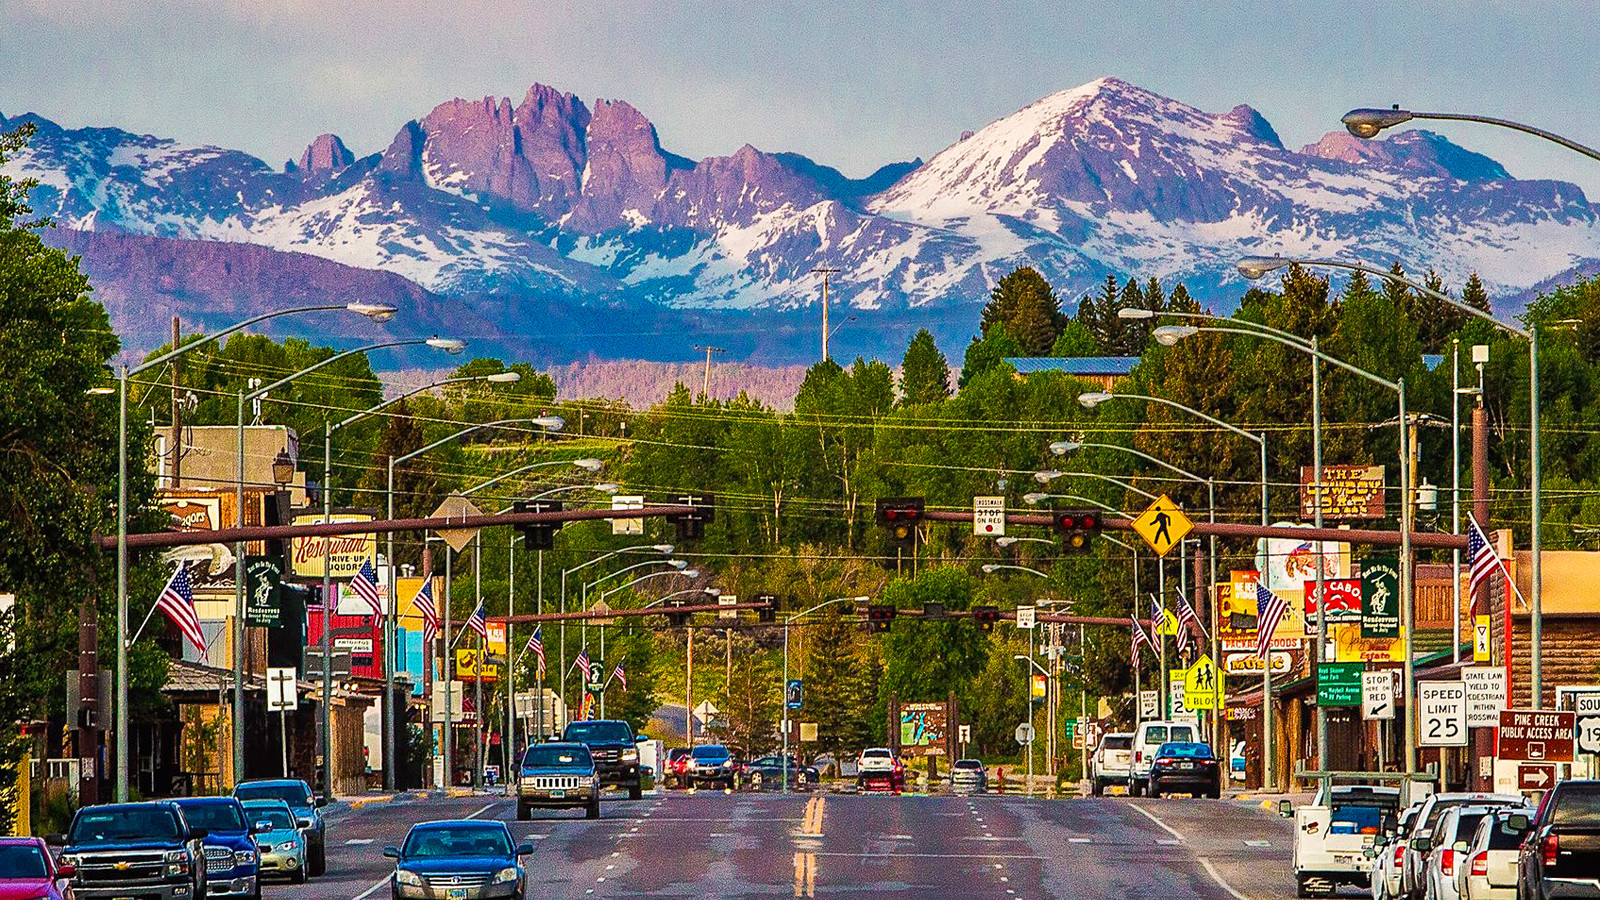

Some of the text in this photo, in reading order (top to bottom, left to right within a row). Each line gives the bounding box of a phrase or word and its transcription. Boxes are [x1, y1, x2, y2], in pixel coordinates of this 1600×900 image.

[1324, 468, 1362, 479] THE
[293, 533, 370, 563] Resturant
[1330, 582, 1362, 600] CABO
[1226, 638, 1297, 648] PACKAG GOODS
[1230, 660, 1284, 670] MUSC
[1424, 690, 1462, 699] SPEED
[1428, 705, 1457, 714] LIMIT
[1514, 714, 1560, 726] PINE CREEK
[1429, 718, 1458, 737] 25
[1501, 726, 1572, 740] PUBLIC ACCESS AREA
